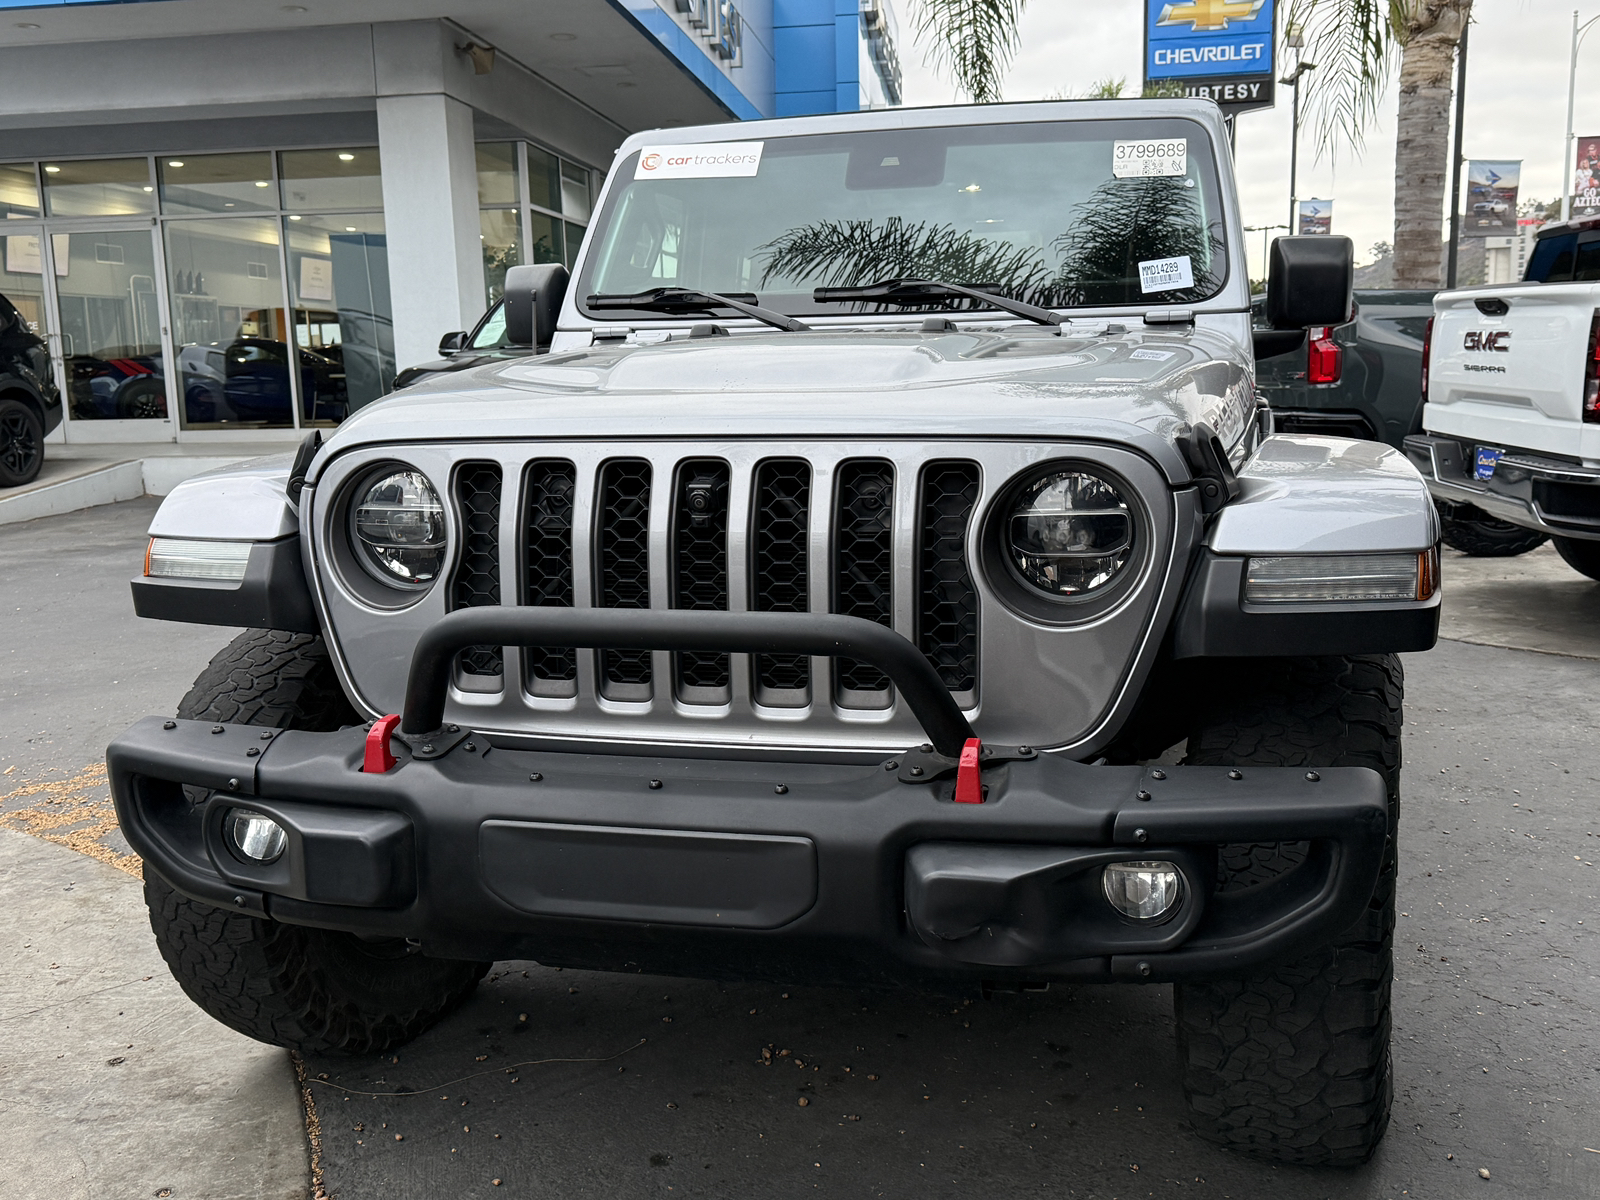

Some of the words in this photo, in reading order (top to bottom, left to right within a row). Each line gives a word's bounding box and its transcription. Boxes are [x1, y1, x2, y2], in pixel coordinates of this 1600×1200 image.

[1154, 43, 1265, 65] CHEVROLET
[1158, 82, 1261, 100] URTESY
[667, 157, 693, 165] car
[694, 153, 757, 165] trackers
[1116, 143, 1186, 159] 3799689
[1583, 188, 1596, 198] GO
[1464, 330, 1512, 352] GMC
[1463, 364, 1506, 373] SIERRA
